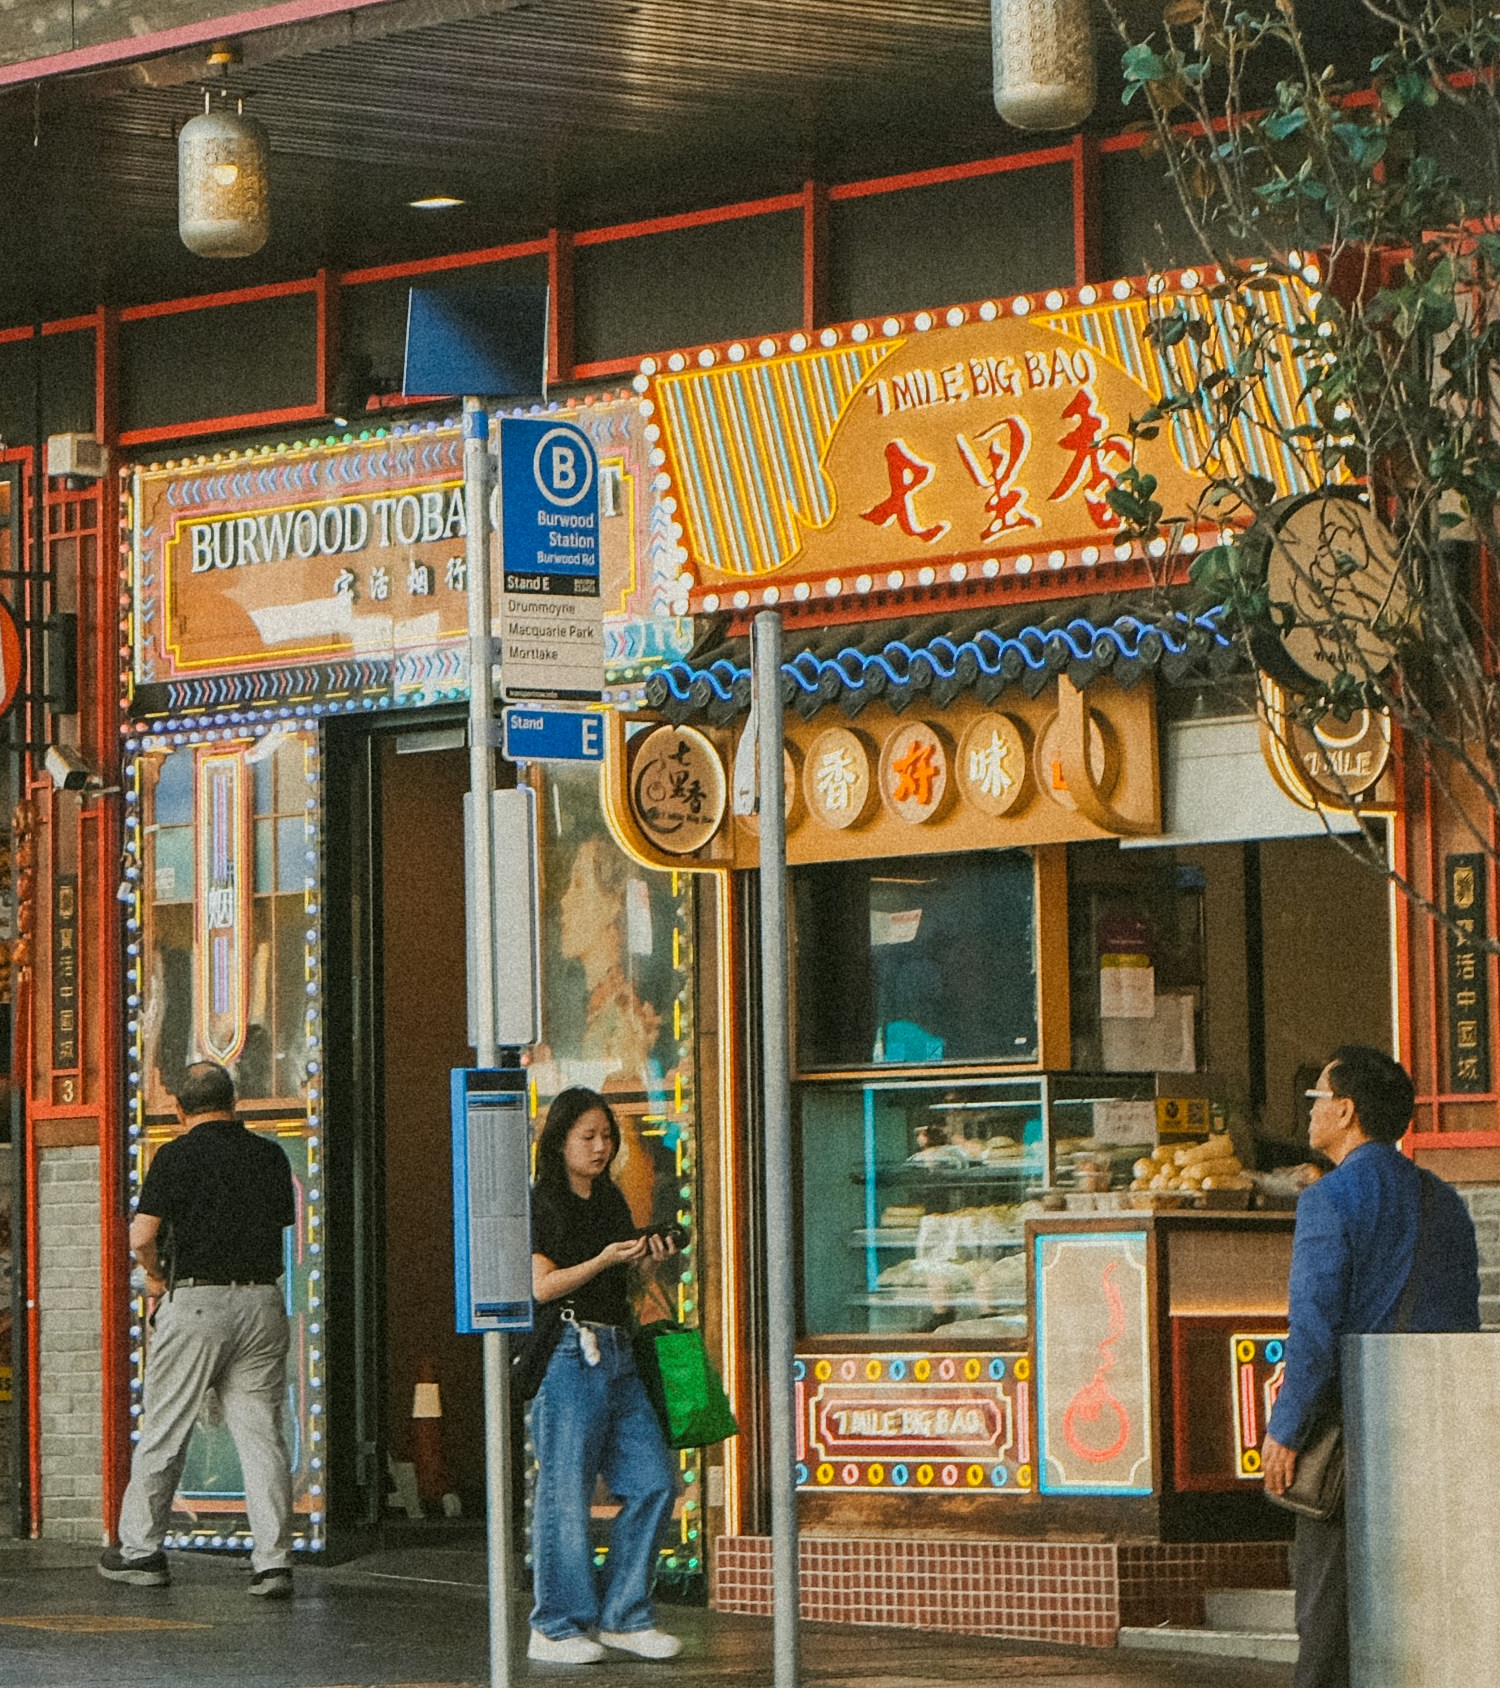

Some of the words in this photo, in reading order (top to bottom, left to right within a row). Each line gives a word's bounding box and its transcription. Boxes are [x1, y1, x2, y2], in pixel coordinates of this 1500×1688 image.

[863, 378, 891, 417] 7
[892, 362, 970, 411] MILE
[968, 356, 1022, 399] BIG
[1024, 346, 1098, 390] BAO
[552, 446, 577, 489] B
[858, 387, 1138, 544] 七里香
[537, 510, 594, 528] Burwood
[191, 502, 368, 574] BURWOOD
[549, 531, 595, 549] Station
[537, 550, 581, 565] Burwood
[581, 553, 595, 566] Rd
[507, 575, 541, 591] Stand
[543, 577, 550, 591] E
[508, 598, 576, 617] Drummoyne
[509, 623, 567, 640] Macquarie
[569, 625, 594, 639] Park
[509, 647, 558, 661] Mortlake
[511, 715, 544, 731] Stand
[582, 718, 599, 756] E
[1304, 751, 1319, 776] 7
[62, 1079, 74, 1102] 3
[832, 1408, 847, 1436] 7
[851, 1408, 899, 1437] MILE
[901, 1407, 931, 1437] BIG
[934, 1406, 981, 1436] BAO
